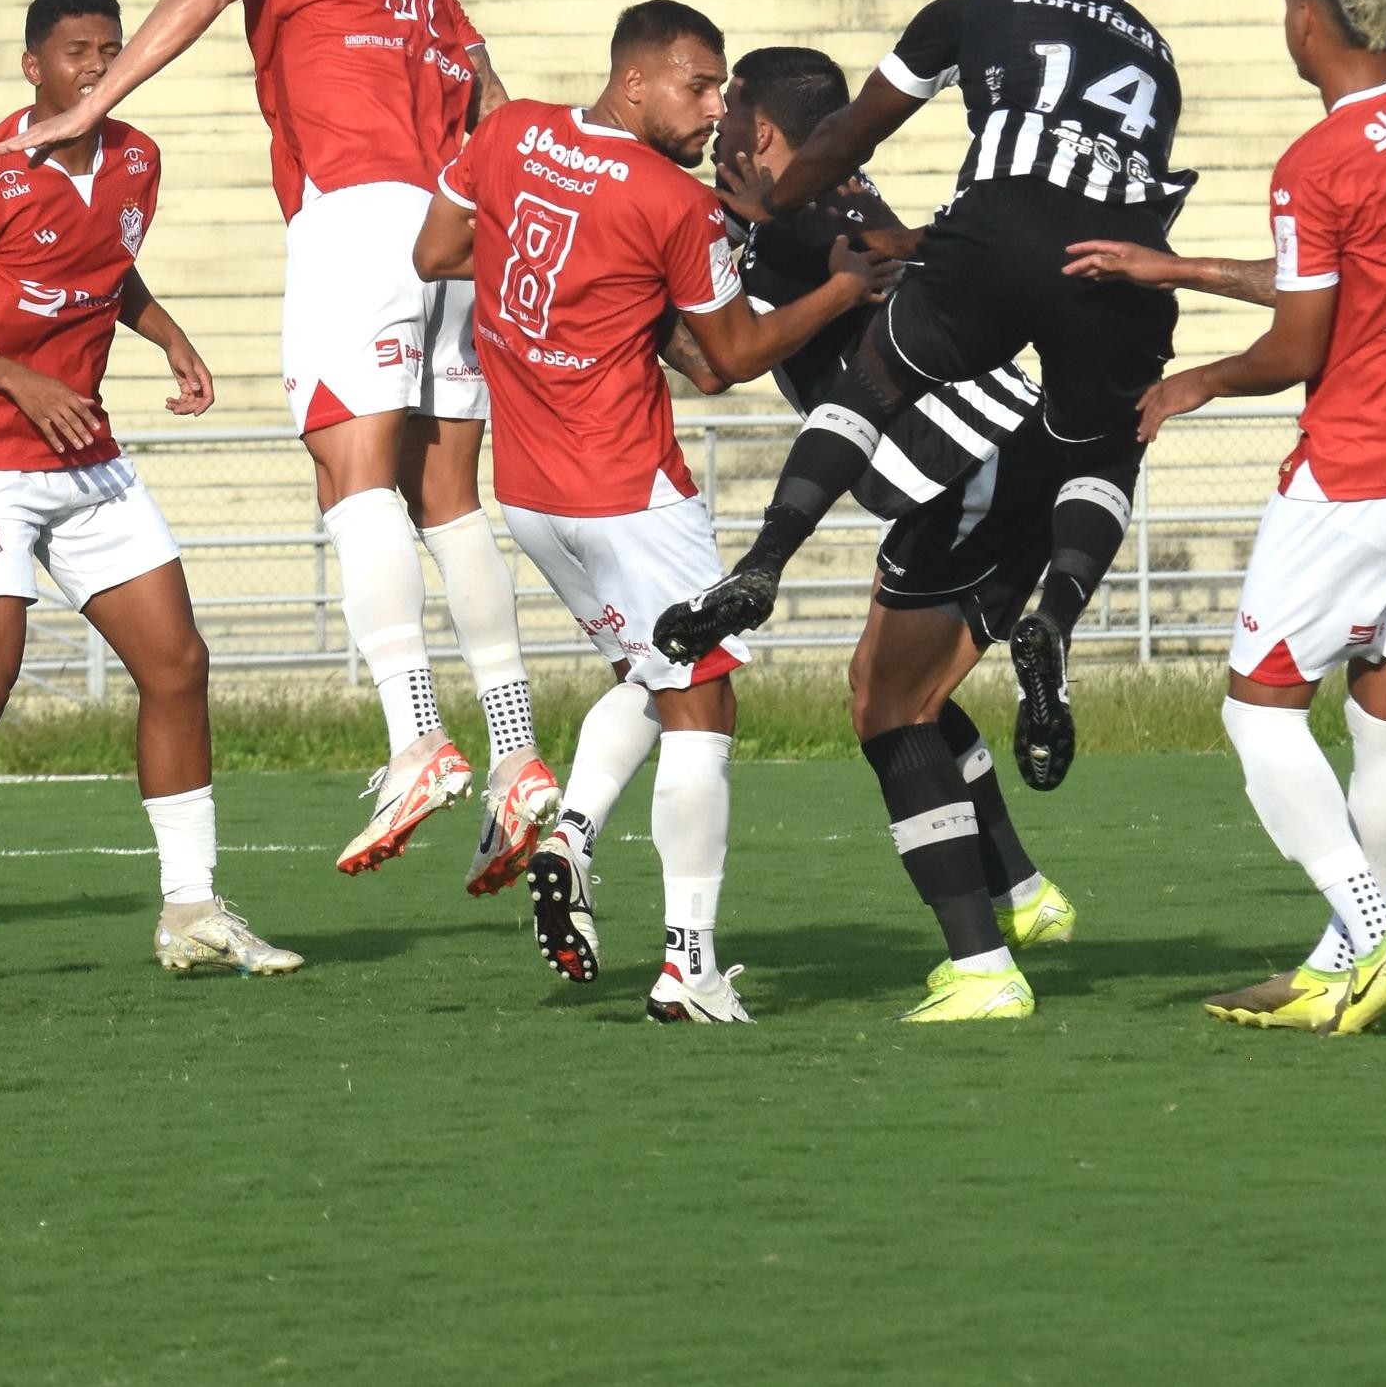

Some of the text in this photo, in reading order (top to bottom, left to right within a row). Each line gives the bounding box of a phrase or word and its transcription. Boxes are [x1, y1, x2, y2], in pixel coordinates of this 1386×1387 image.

[344, 34, 383, 46] SINDIPETRO
[1033, 43, 1157, 140] 14
[517, 125, 629, 182] gbarbosa
[1, 183, 31, 200] ocular
[523, 159, 597, 195] cencosud
